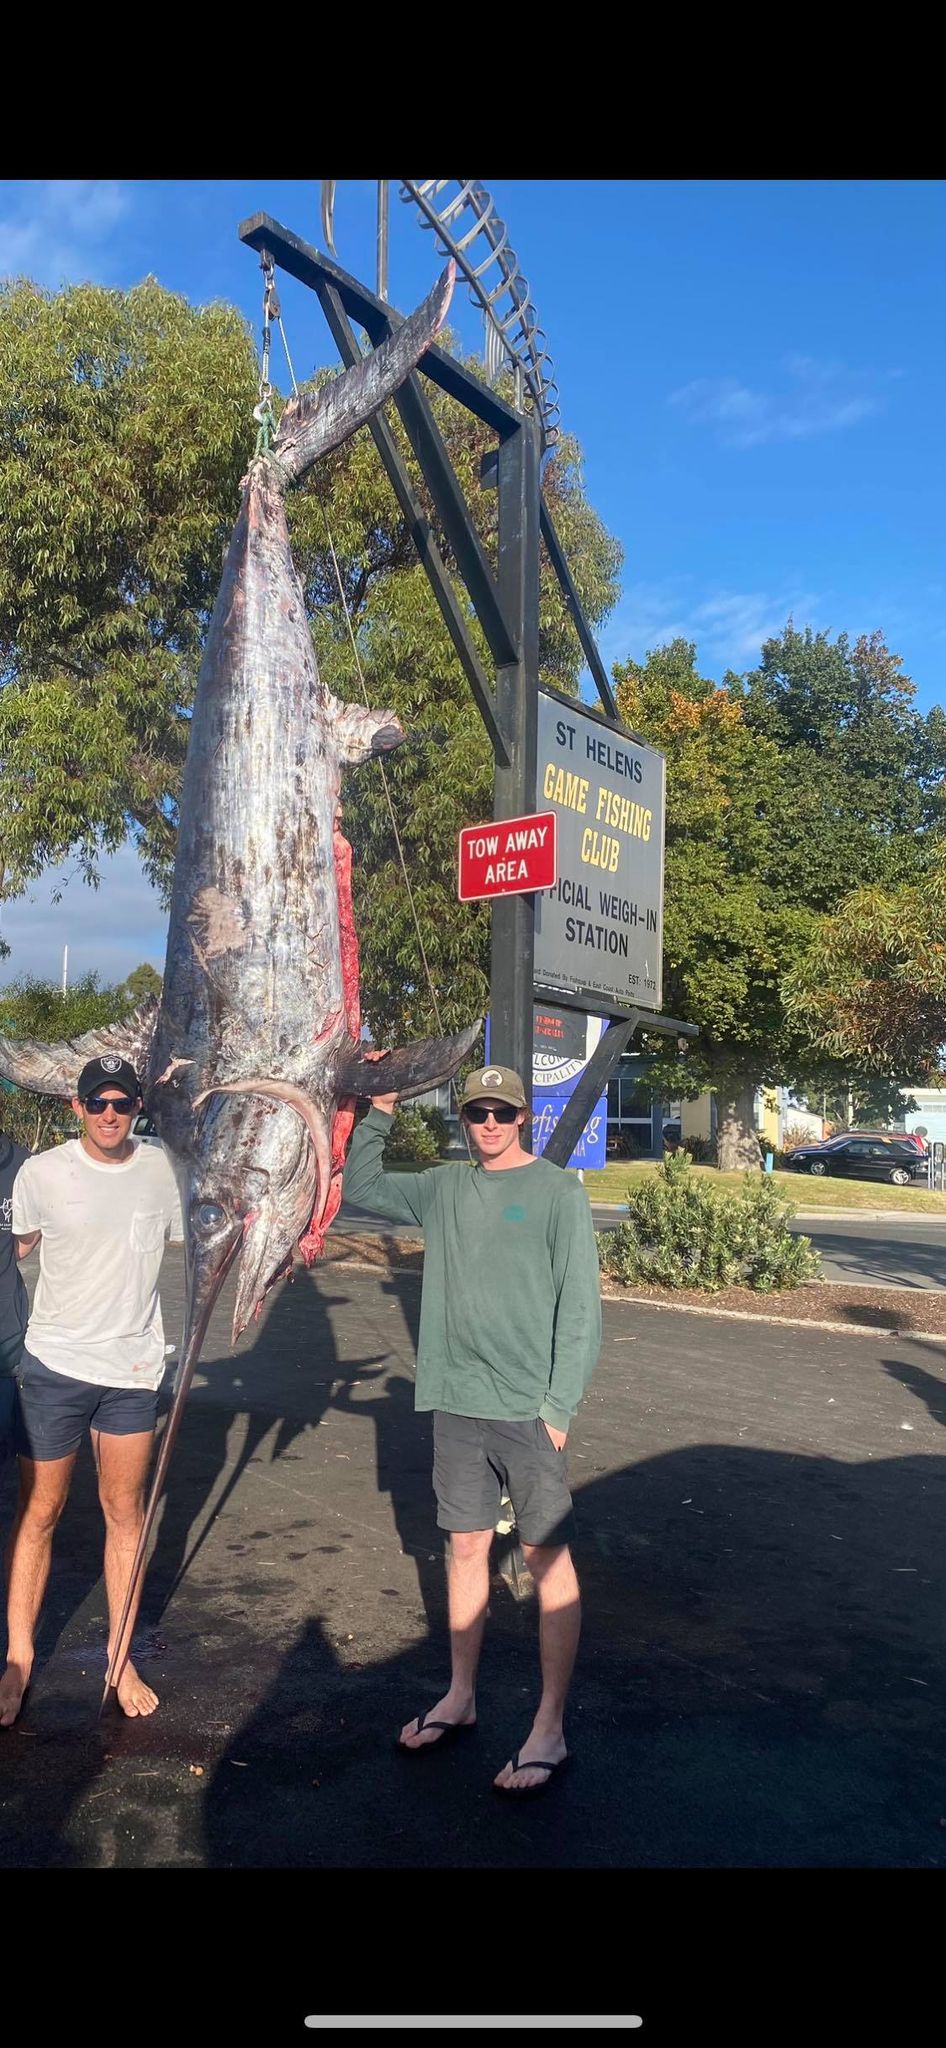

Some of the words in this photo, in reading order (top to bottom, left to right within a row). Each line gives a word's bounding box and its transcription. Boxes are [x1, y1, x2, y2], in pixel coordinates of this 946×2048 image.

[556, 721, 576, 750] ST
[586, 735, 642, 784] HELENS
[543, 763, 590, 815] GAME
[595, 786, 652, 842] FISHING
[467, 836, 499, 859] TOW
[505, 826, 548, 853] AWAY
[581, 827, 620, 873] CLUB
[484, 859, 528, 885] AREA
[541, 877, 592, 911] FICIAL
[600, 891, 657, 932] WEIGH-IN
[565, 917, 628, 957] STATION
[643, 978, 657, 991] 1972
[534, 1060, 583, 1083] CIPALITY
